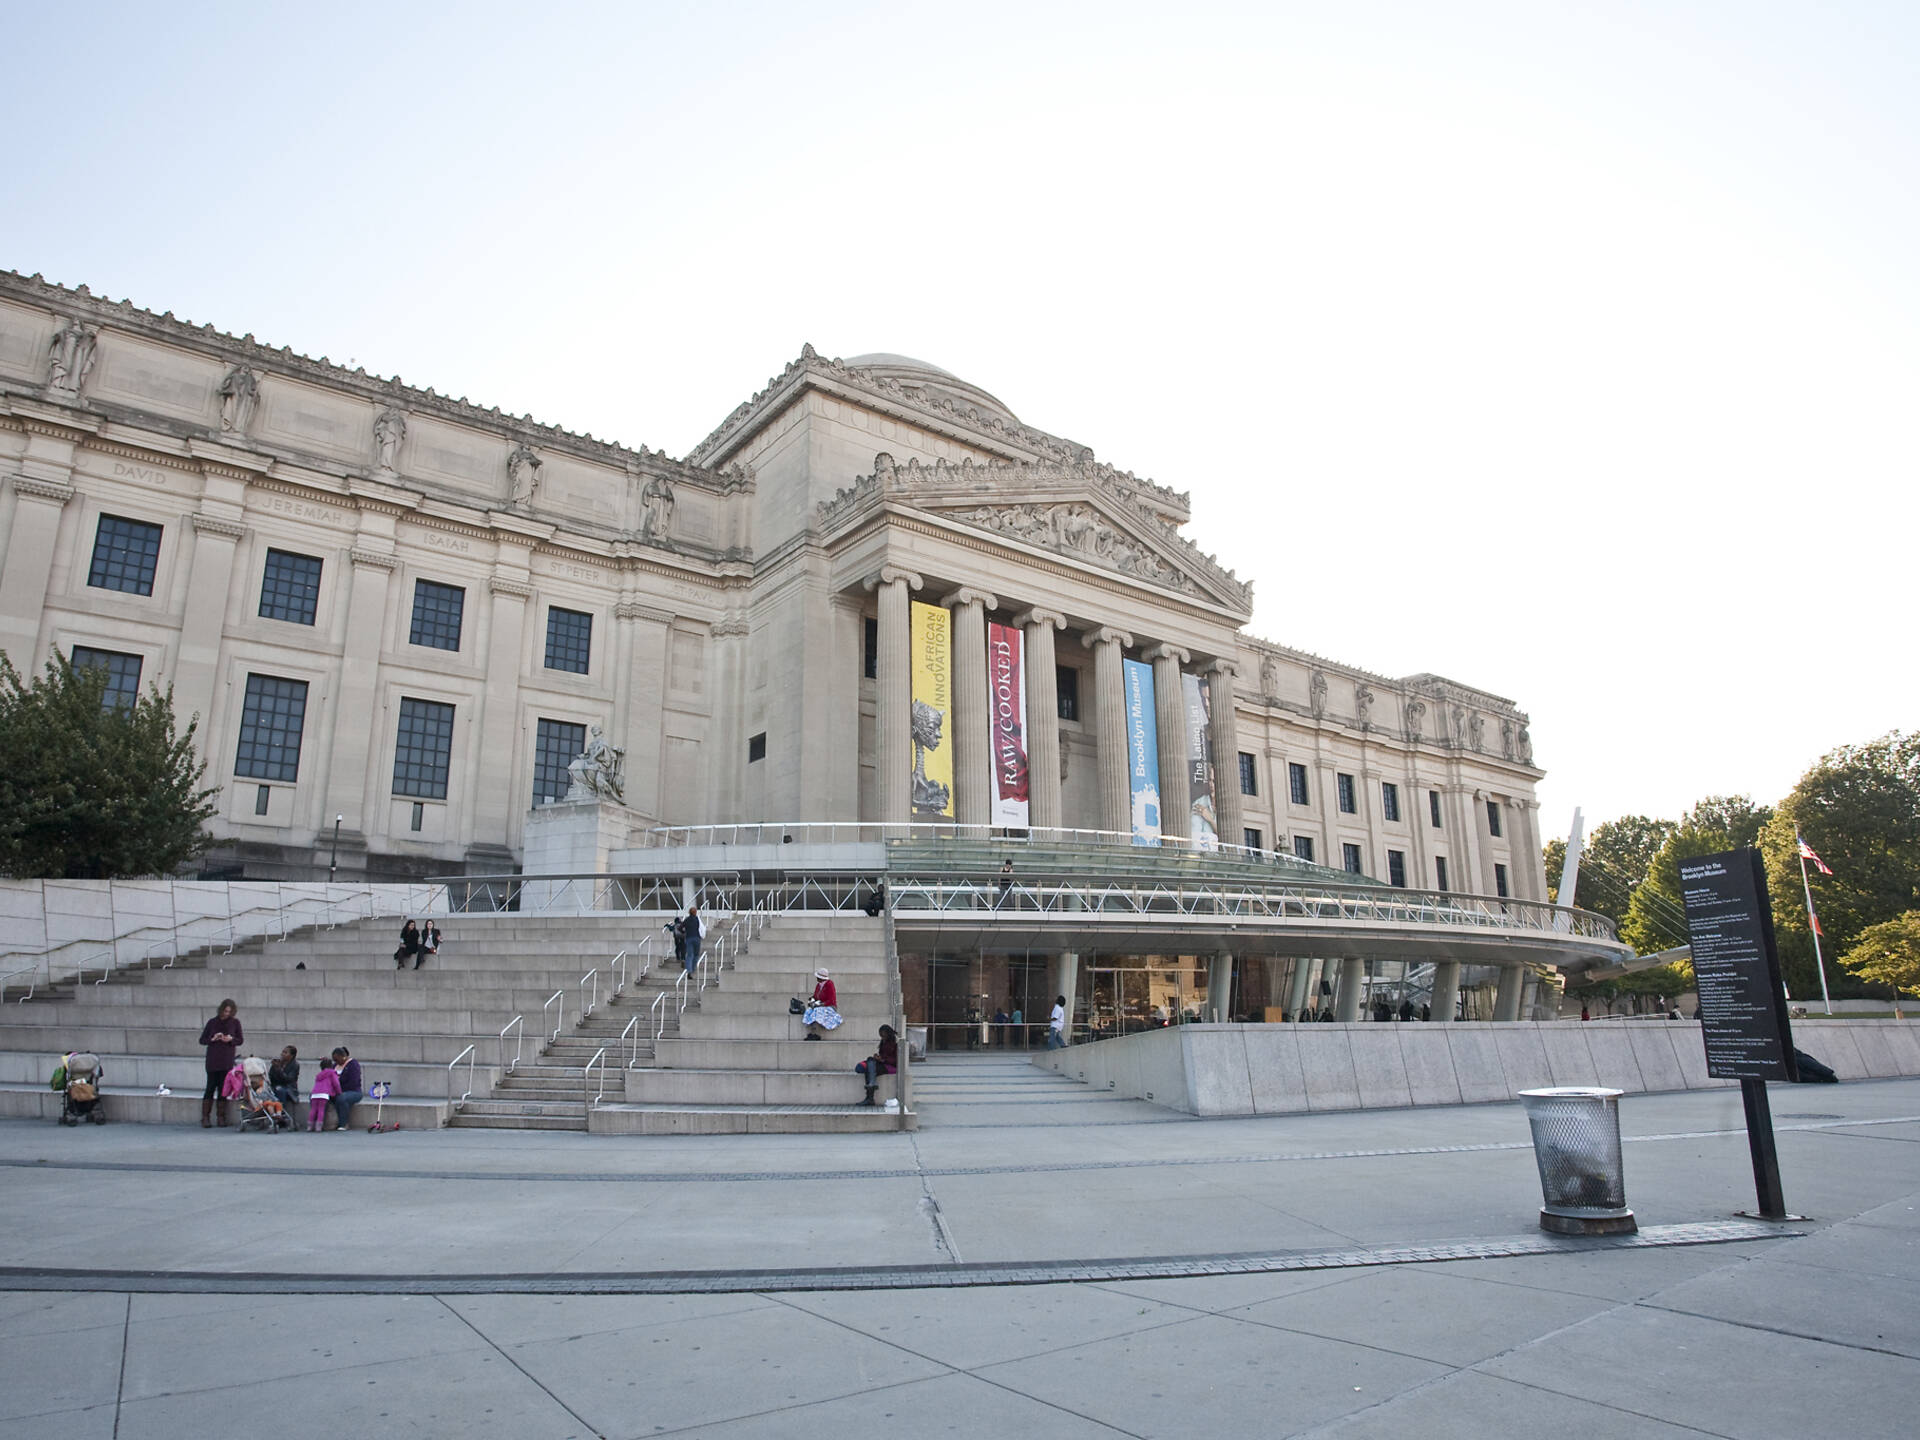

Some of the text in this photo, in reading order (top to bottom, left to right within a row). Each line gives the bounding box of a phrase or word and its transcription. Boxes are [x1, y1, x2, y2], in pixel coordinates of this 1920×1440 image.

[113, 463, 167, 485] DAVID
[262, 495, 343, 525] JEREMIAH
[423, 533, 470, 552] ISAIAH
[925, 611, 937, 673] AFRICAN
[935, 613, 946, 707] INNOVATIONS
[997, 641, 1017, 785] RAW/COOKED
[1130, 667, 1146, 778] Brooklyn Museum
[1190, 704, 1204, 784] The Latino List
[1681, 866, 1705, 874] Welcome
[1682, 869, 1727, 880] Brooklyn Museum
